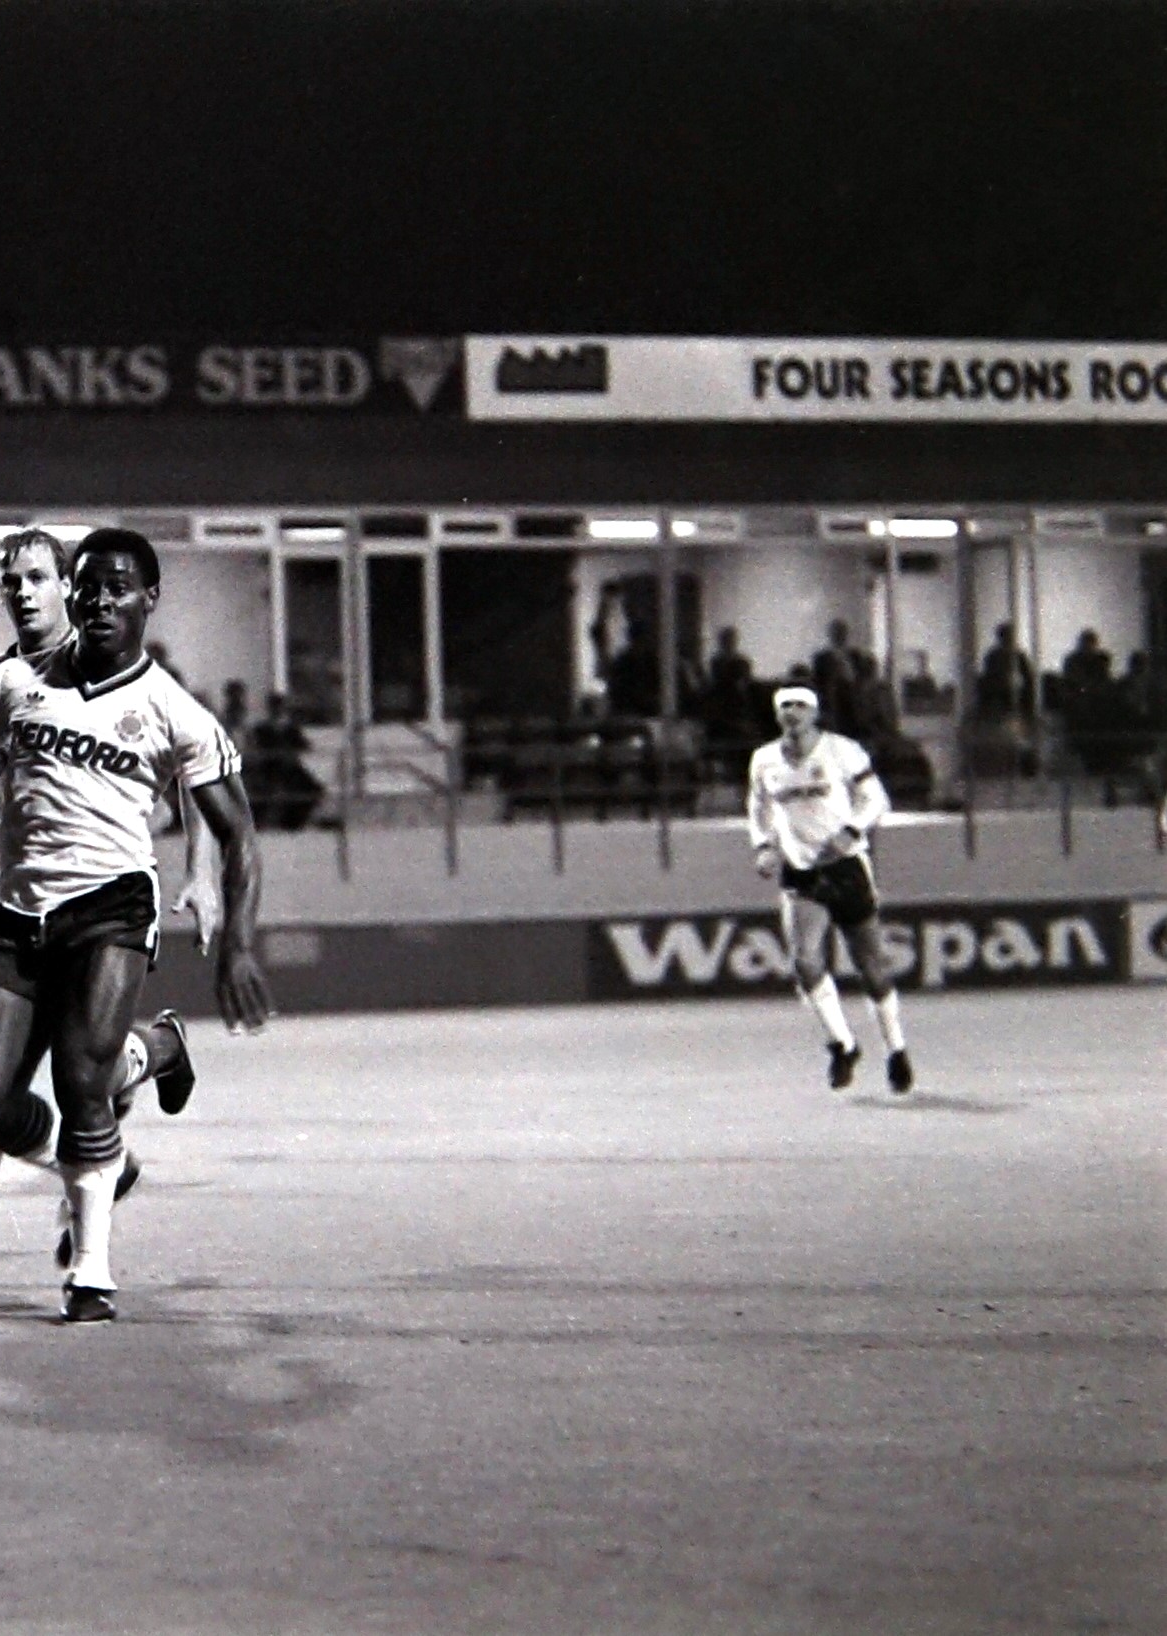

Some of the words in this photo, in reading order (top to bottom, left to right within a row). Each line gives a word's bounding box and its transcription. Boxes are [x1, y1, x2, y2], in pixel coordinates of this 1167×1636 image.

[196, 345, 371, 403] SEED
[752, 357, 871, 400] FOUR
[889, 358, 1072, 401] SEASONS
